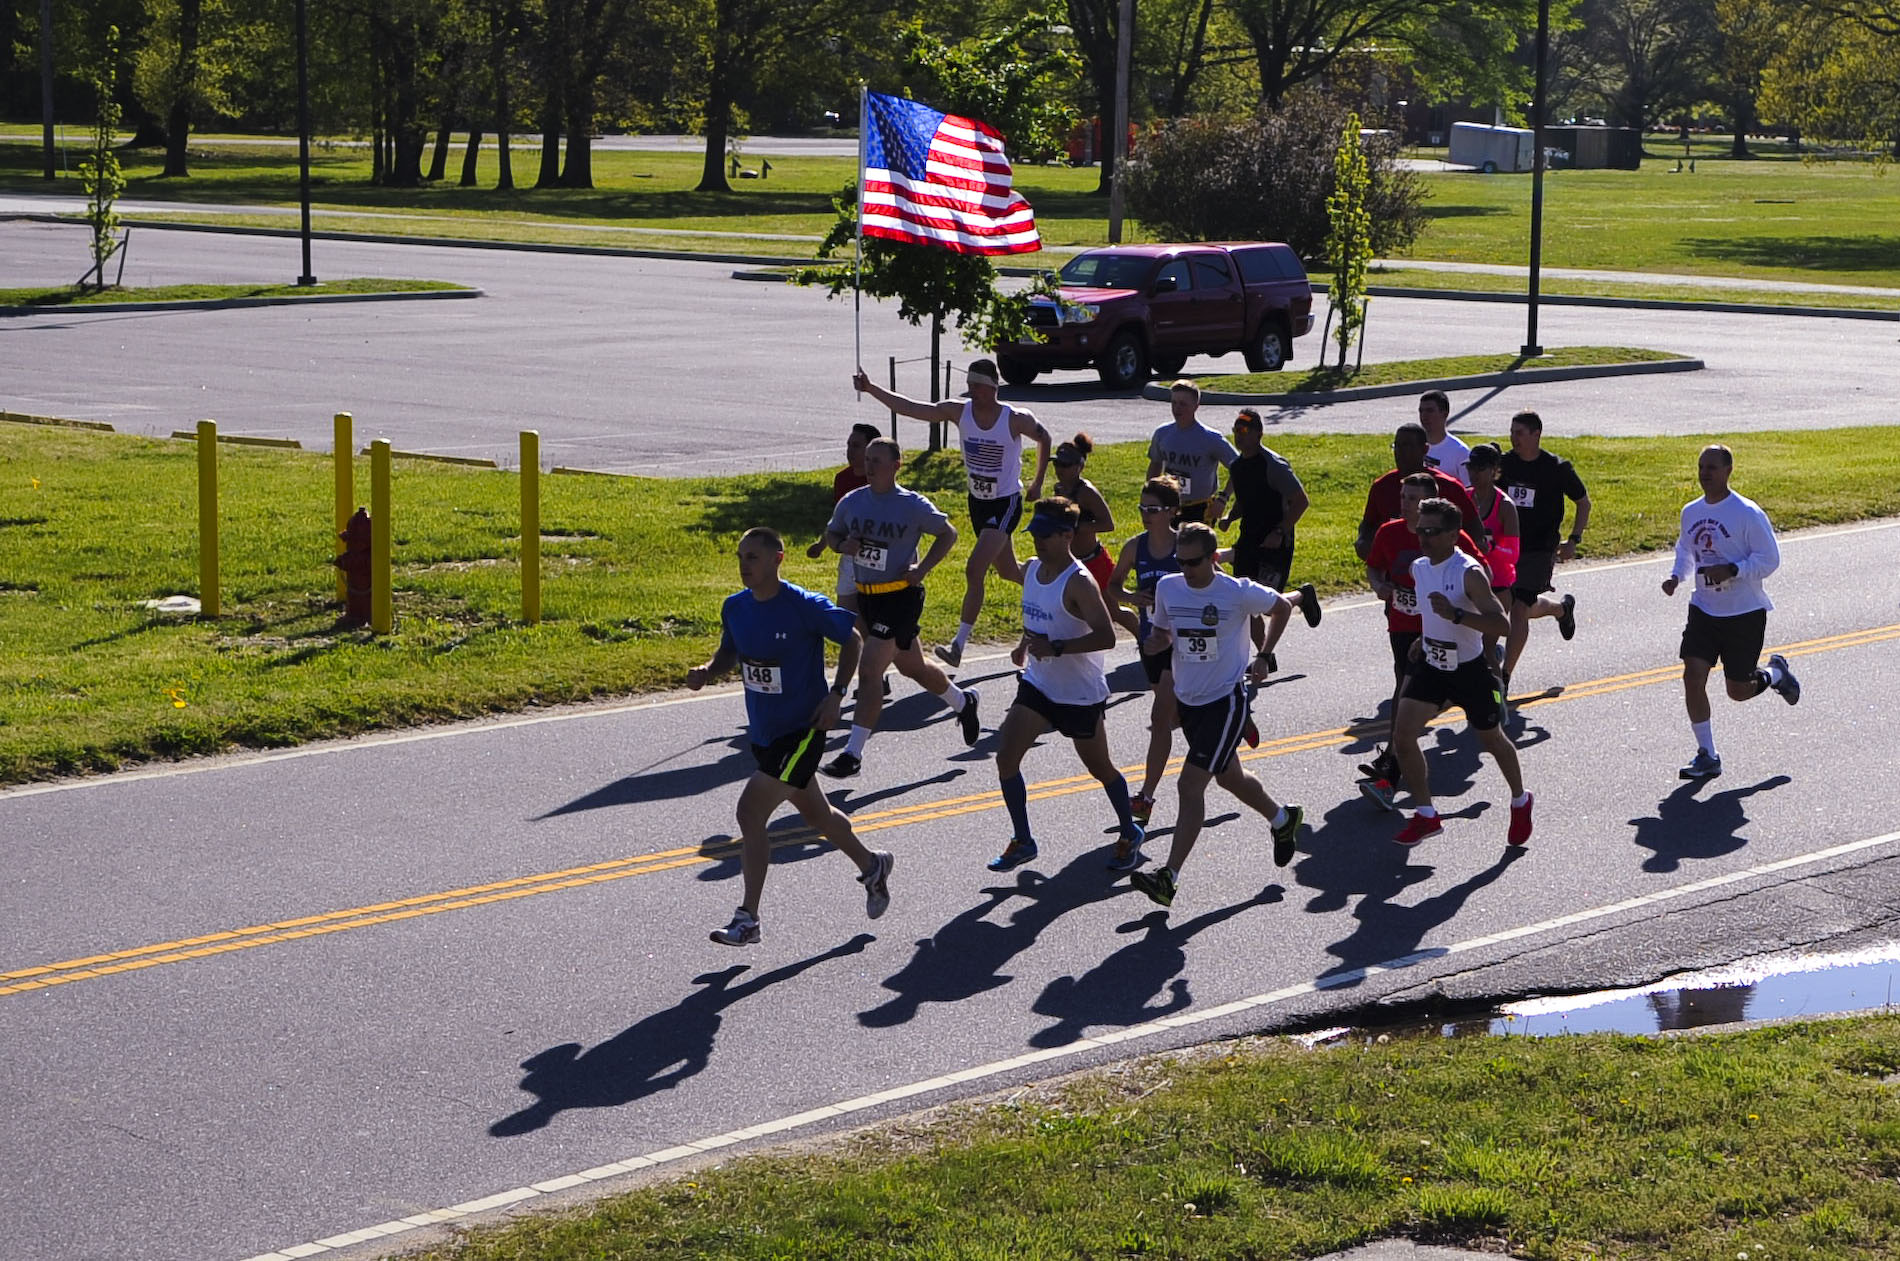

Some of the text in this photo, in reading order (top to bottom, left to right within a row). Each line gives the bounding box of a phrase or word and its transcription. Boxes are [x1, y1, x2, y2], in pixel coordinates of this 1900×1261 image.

[1160, 450, 1201, 468] ARMY
[973, 480, 992, 493] 264
[1514, 487, 1527, 499] 89
[850, 516, 908, 539] ARMY
[1396, 591, 1417, 607] 265
[1188, 638, 1207, 652] 39
[1431, 647, 1448, 662] 52
[747, 666, 773, 683] 148
